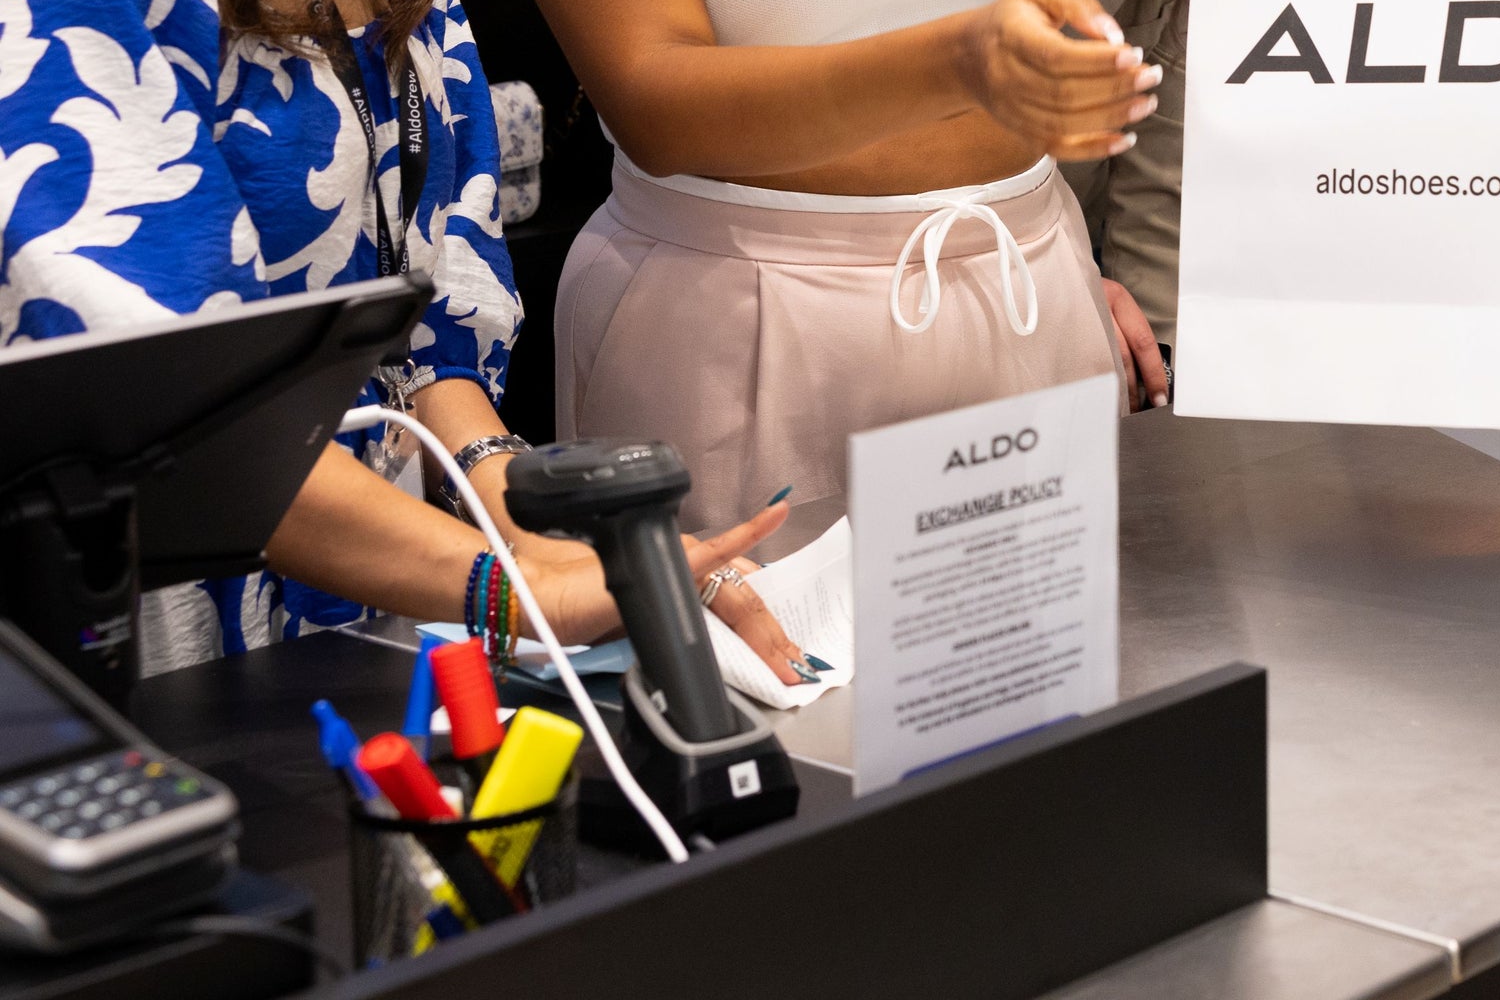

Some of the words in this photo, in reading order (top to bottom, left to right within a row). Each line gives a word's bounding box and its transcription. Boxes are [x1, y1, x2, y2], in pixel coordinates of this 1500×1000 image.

[408, 69, 423, 154] #AldoCrew
[380, 229, 391, 276] #Aldo
[943, 427, 1039, 474] ALDO
[915, 490, 1004, 533] EXCHANGE
[1008, 476, 1064, 507] POLICY
